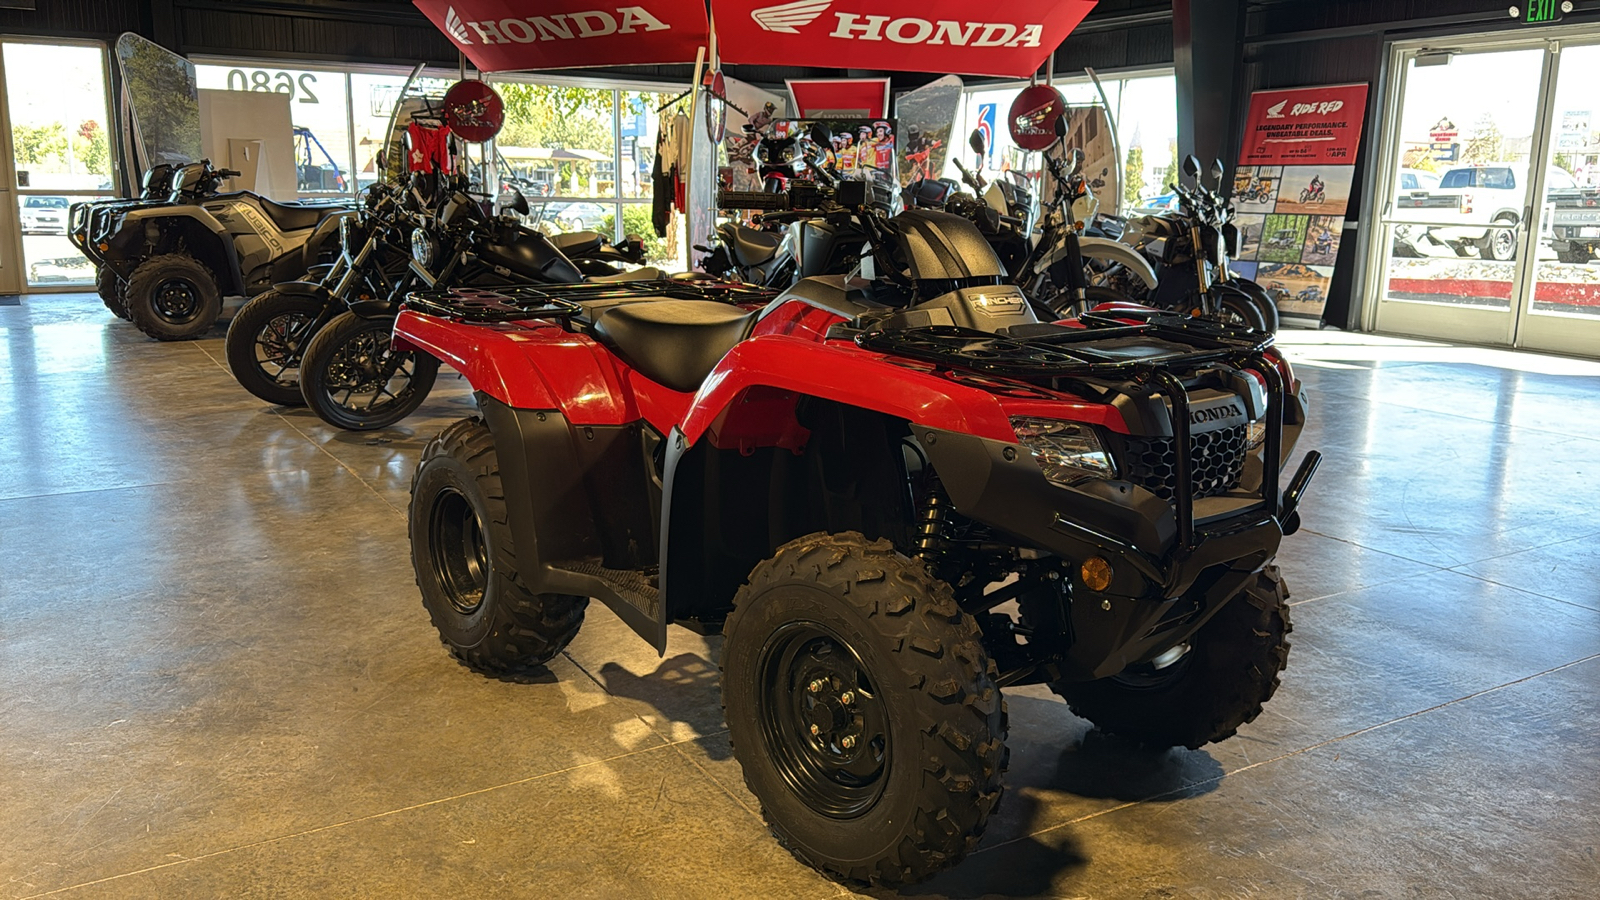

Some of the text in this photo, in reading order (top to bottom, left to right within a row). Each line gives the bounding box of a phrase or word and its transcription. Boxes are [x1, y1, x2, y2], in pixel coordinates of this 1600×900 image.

[1526, 0, 1556, 22] EXIT
[467, 6, 671, 45] HONDA
[829, 12, 1043, 47] HONDA
[1290, 101, 1344, 116] RIDE RED
[1016, 128, 1053, 136] HONDA
[238, 202, 284, 255] RUBICON
